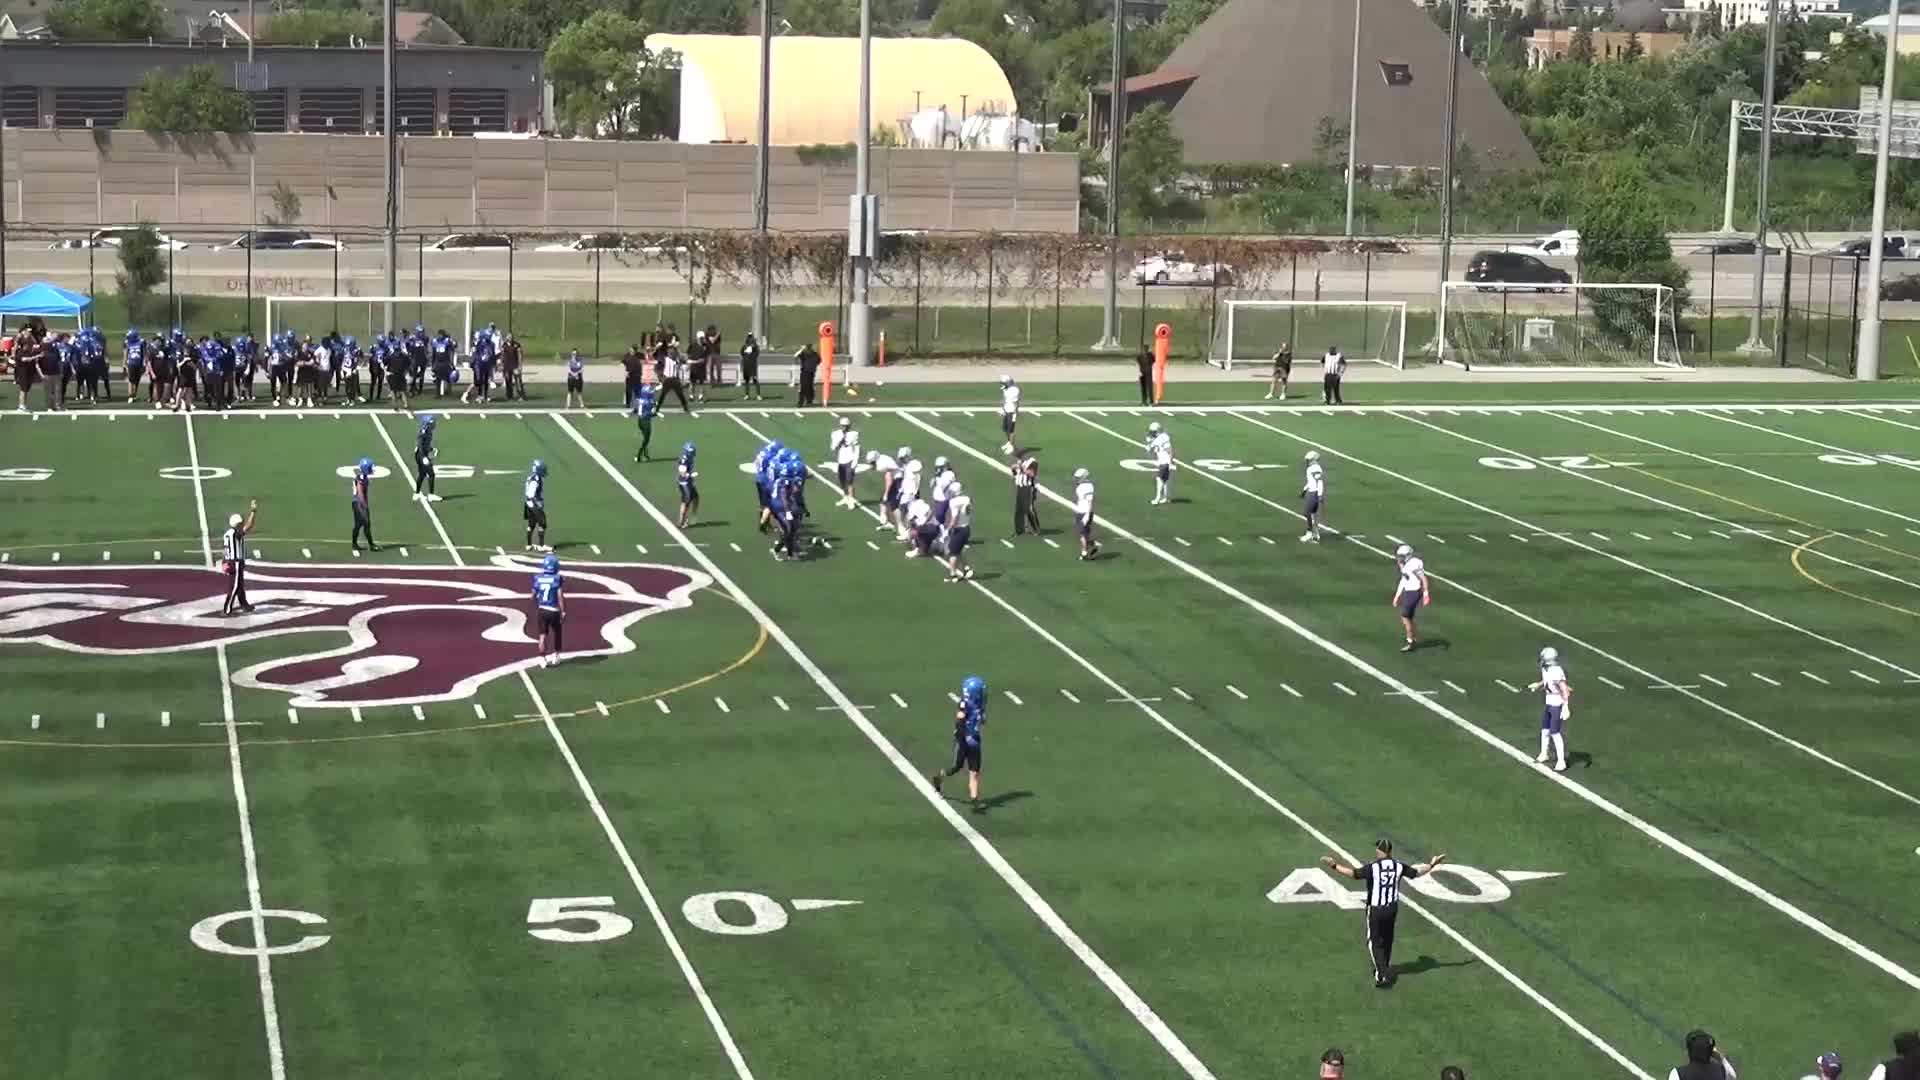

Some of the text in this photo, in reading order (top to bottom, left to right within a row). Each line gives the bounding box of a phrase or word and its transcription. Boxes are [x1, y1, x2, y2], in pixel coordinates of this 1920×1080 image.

[539, 583, 551, 601] 7
[1379, 871, 1396, 886] 57
[189, 909, 331, 956] C
[527, 891, 788, 942] 50
